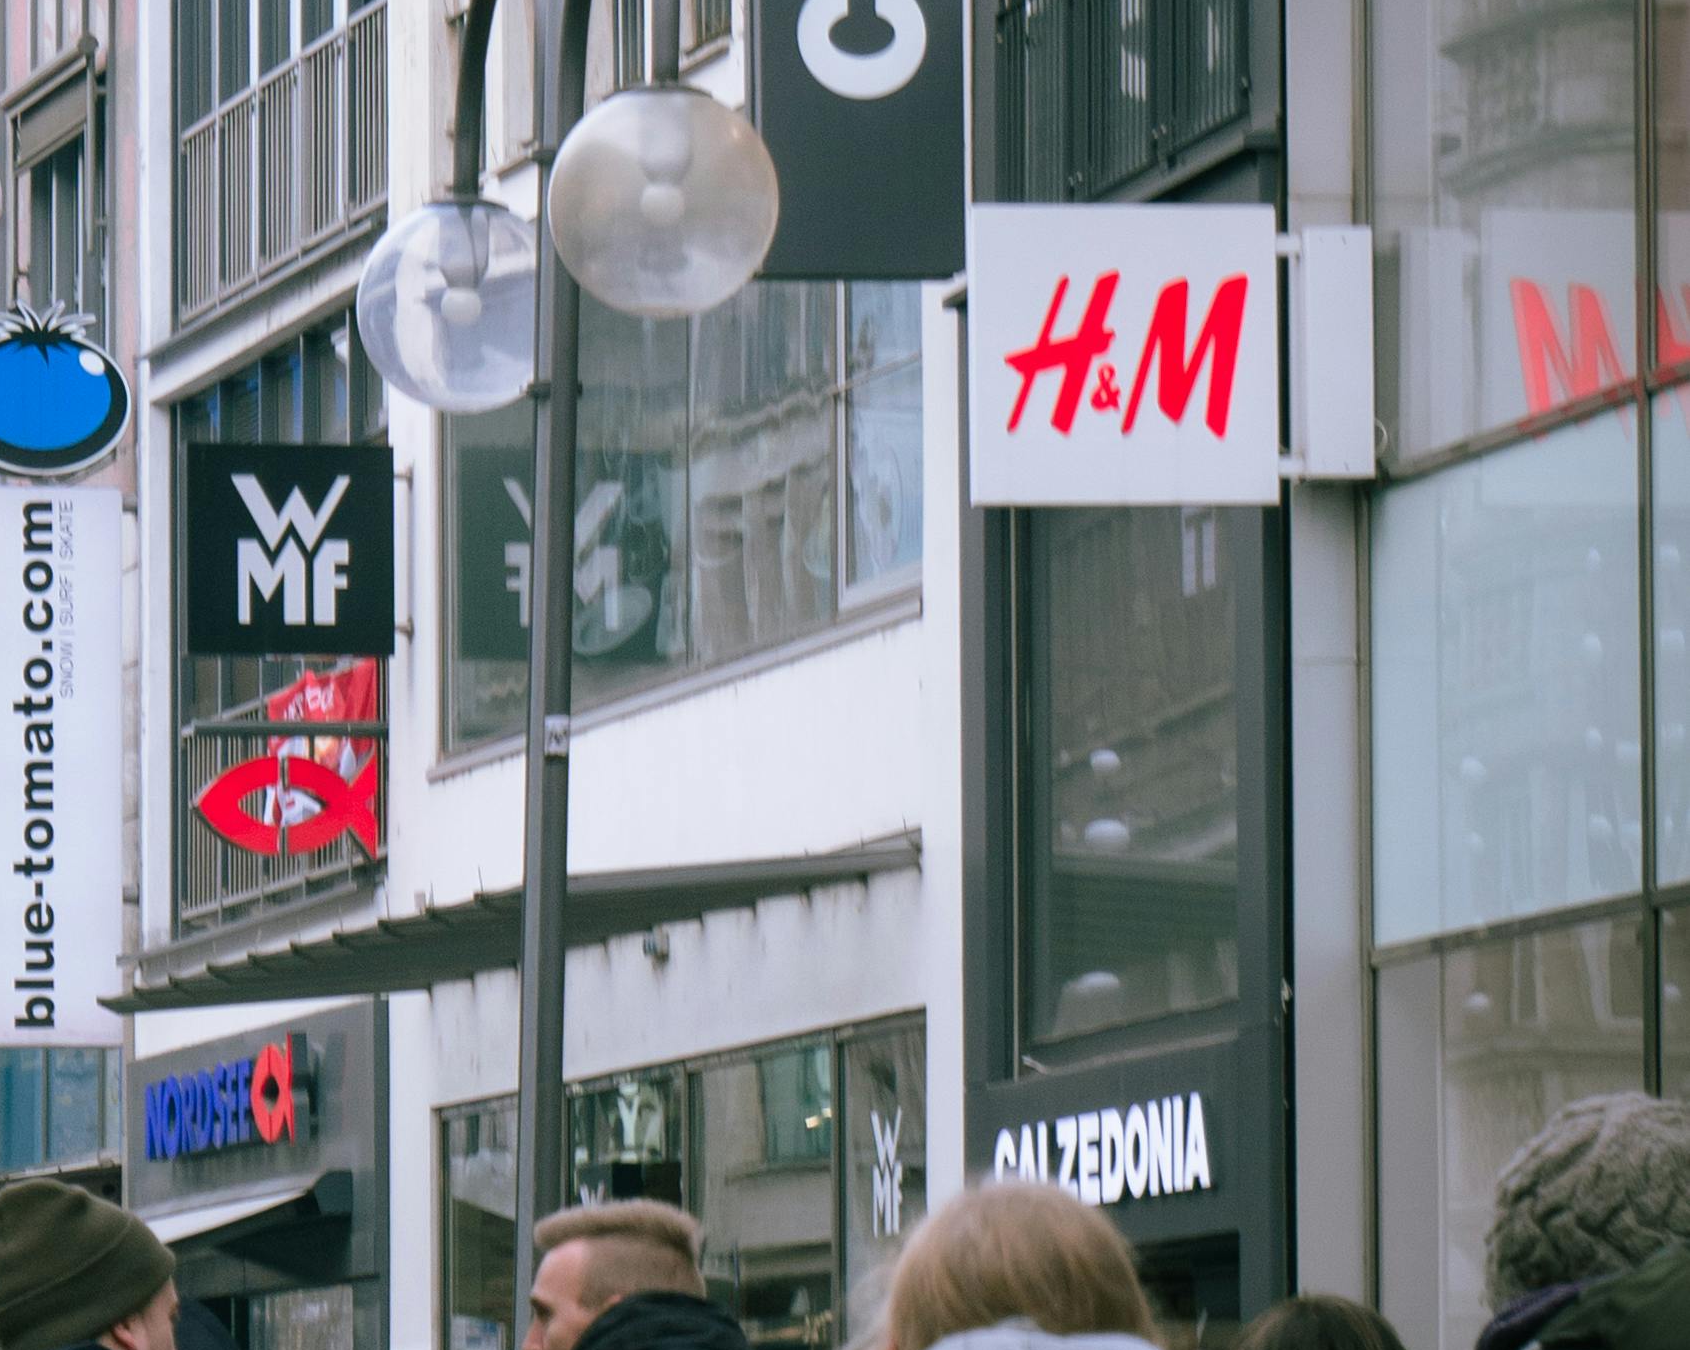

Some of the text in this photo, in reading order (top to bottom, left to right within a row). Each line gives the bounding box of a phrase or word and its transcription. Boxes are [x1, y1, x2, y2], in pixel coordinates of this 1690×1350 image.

[1004, 270, 1249, 440] H&M
[60, 500, 73, 699] SNOW SURF SKATE
[13, 498, 56, 1030] blue-tomato.com
[145, 1057, 252, 1162] NORDSEE
